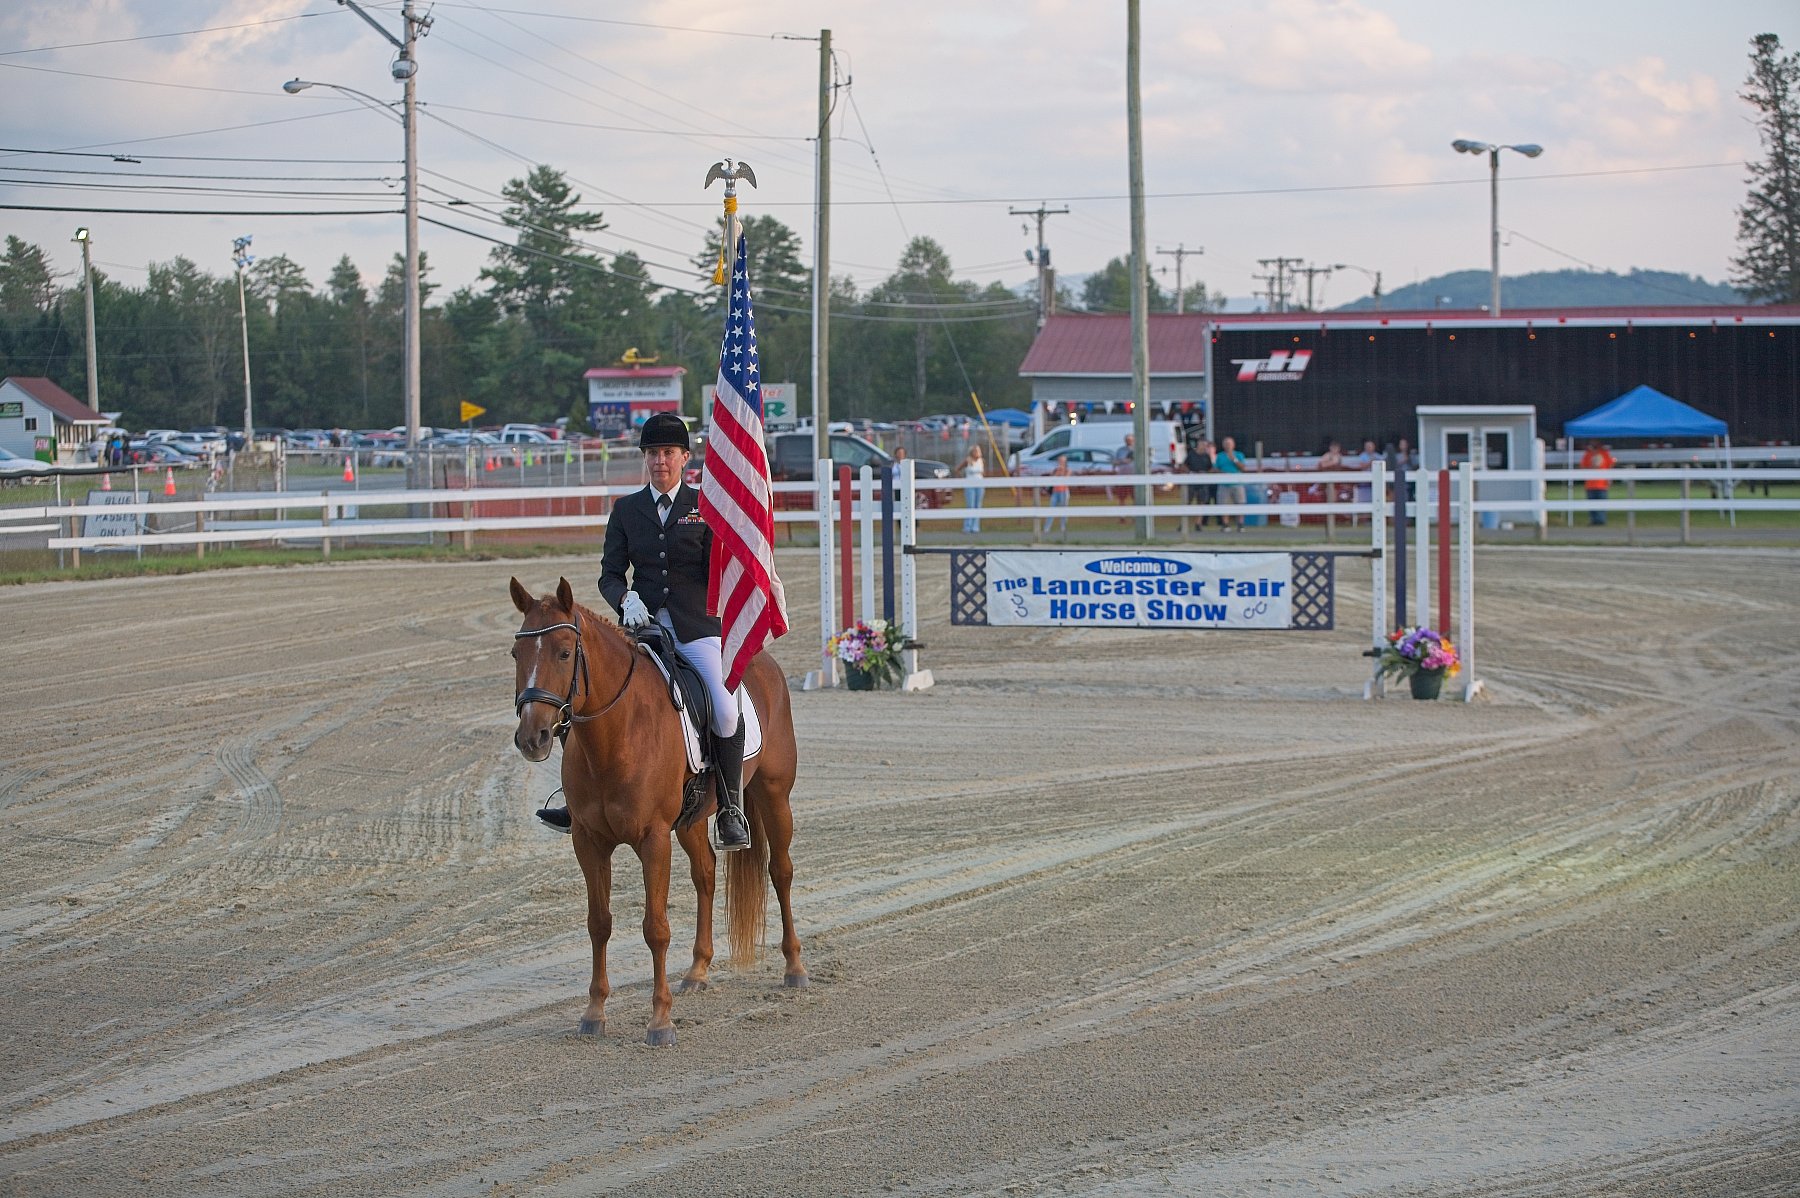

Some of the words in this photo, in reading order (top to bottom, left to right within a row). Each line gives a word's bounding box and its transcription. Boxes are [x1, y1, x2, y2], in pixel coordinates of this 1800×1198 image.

[104, 496, 132, 505] BLUE
[101, 529, 127, 537] ONLY
[1100, 560, 1162, 574] Welcome
[1164, 561, 1178, 574] to
[993, 577, 1028, 592] The
[1032, 576, 1206, 597] Lancaster
[1219, 577, 1286, 598] Fair
[1050, 599, 1136, 620] Horse
[1147, 599, 1227, 621] Show
